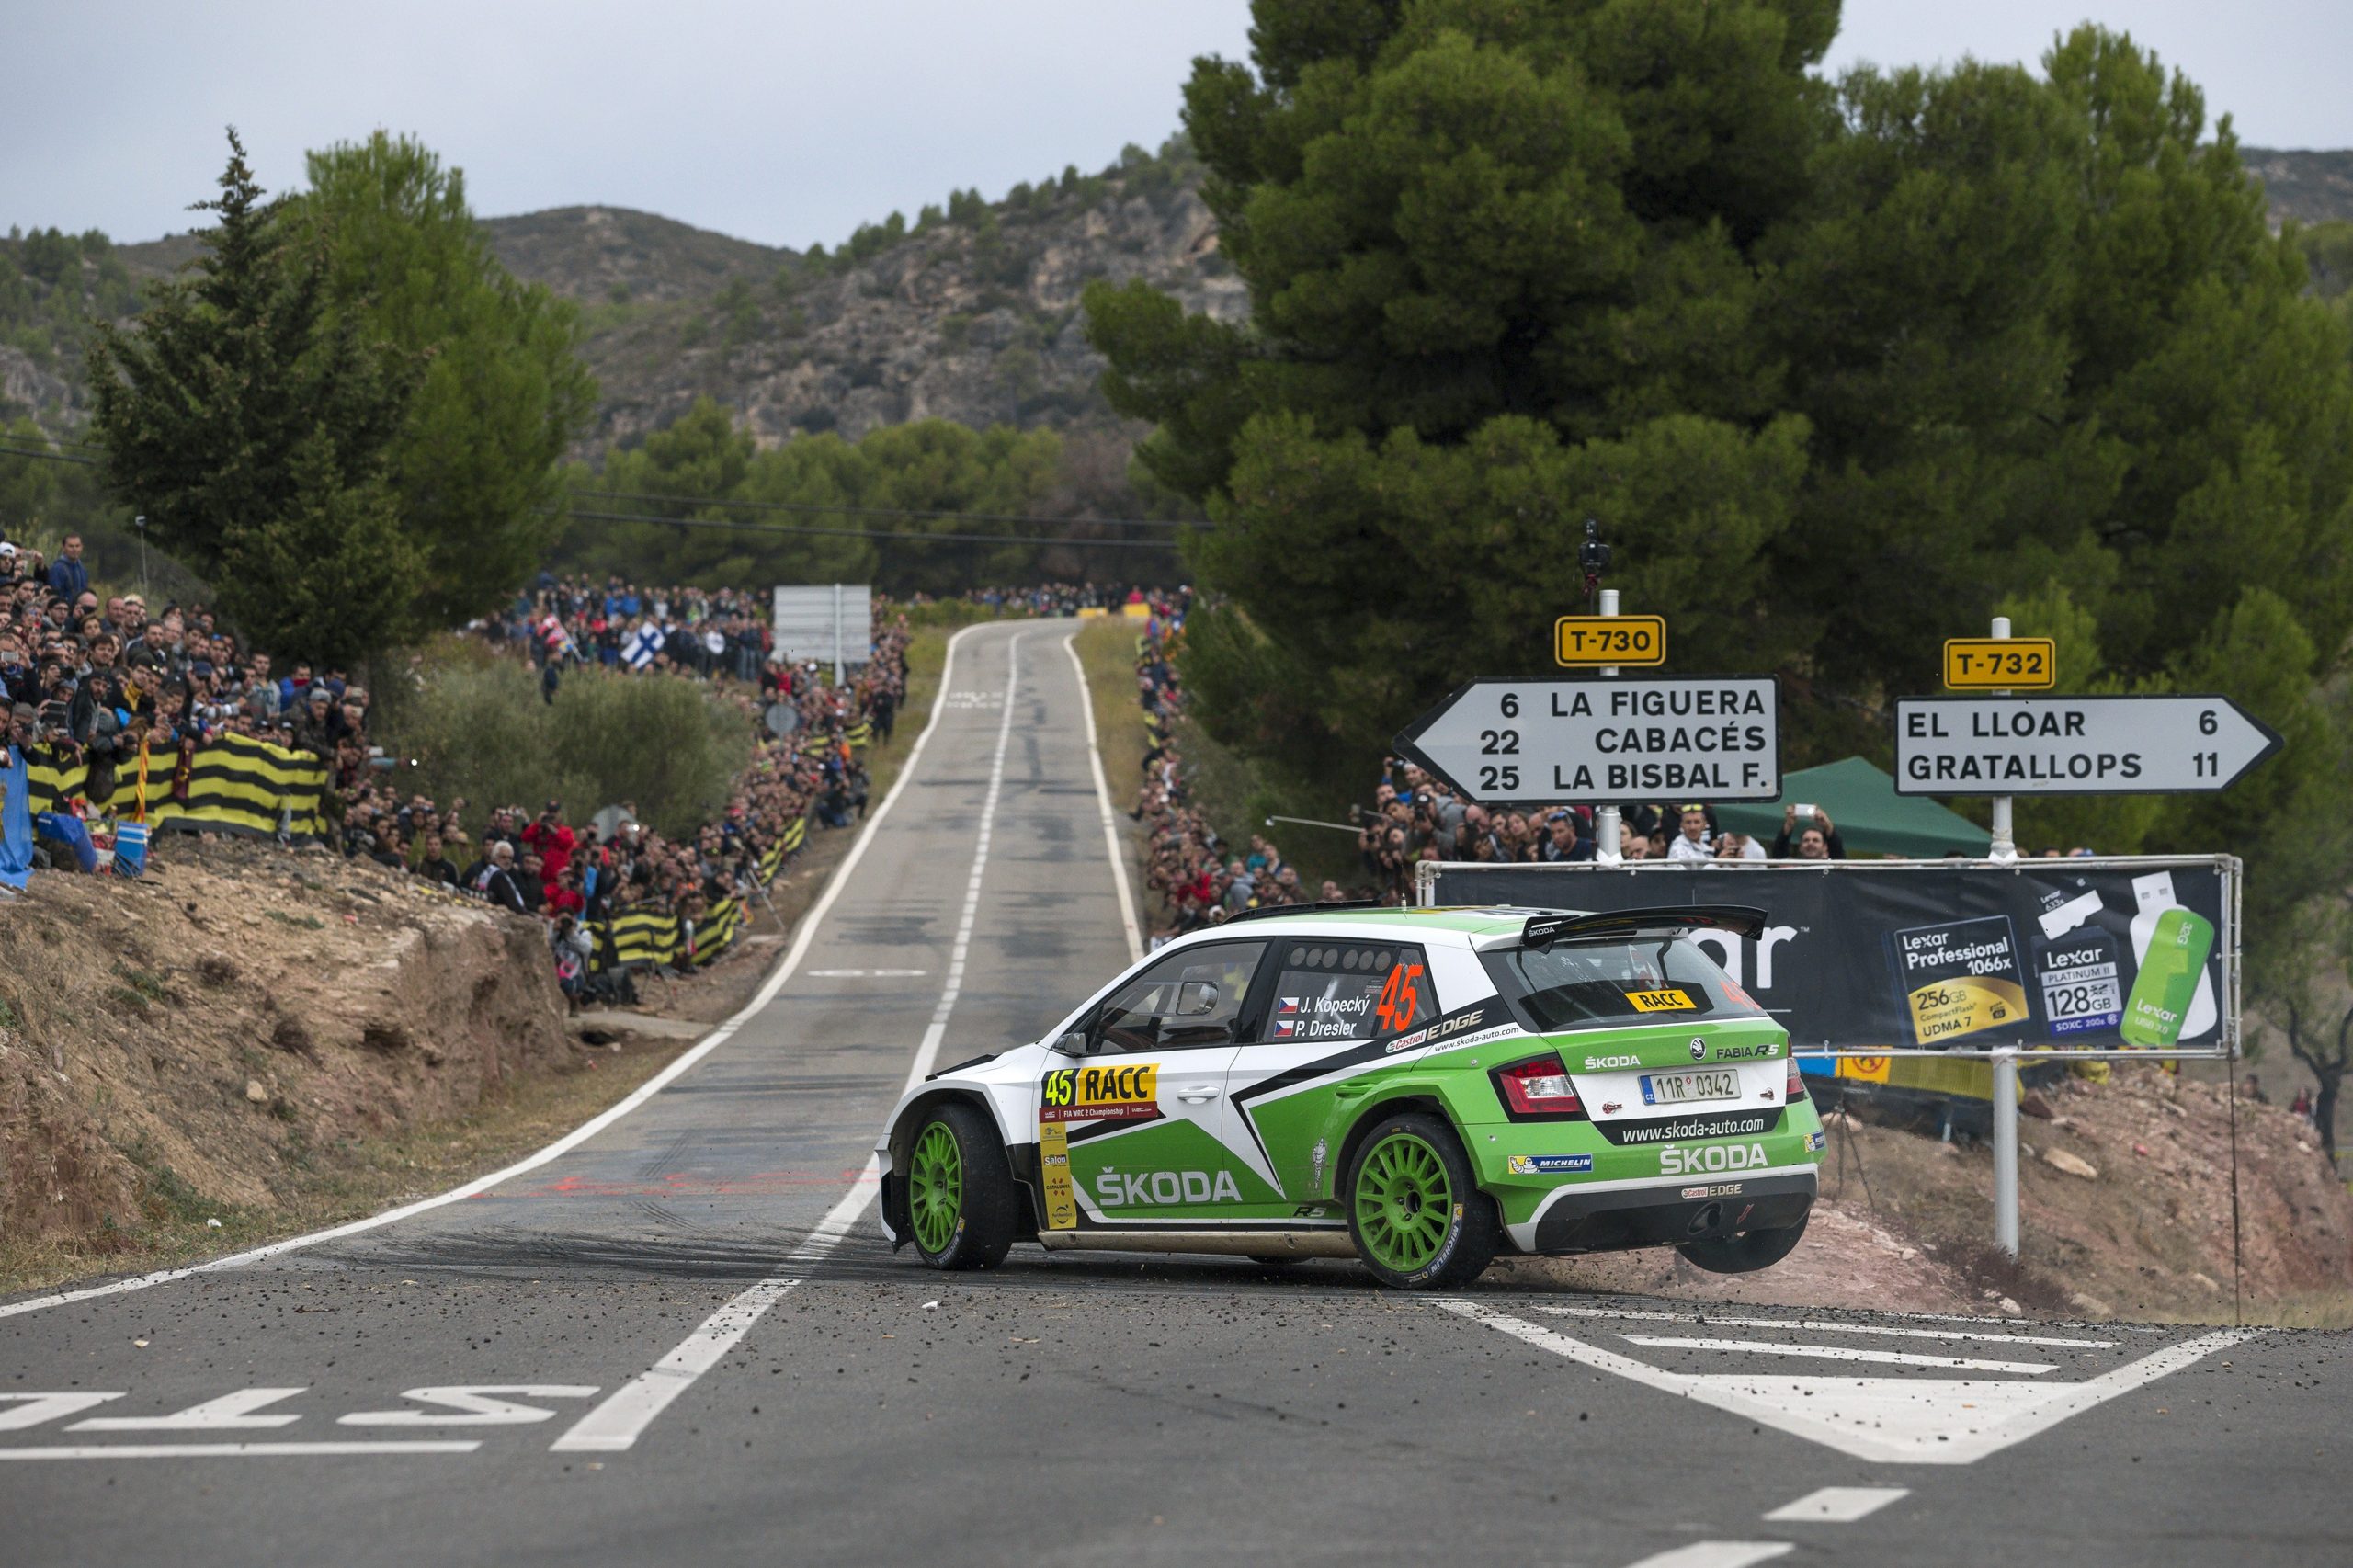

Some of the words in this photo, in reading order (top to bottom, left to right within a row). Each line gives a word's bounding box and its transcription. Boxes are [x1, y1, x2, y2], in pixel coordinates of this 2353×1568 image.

[1570, 630, 1651, 653] T-730
[1957, 653, 2043, 676] T-732
[1500, 693, 1519, 719] 6
[1552, 692, 1593, 718] LA
[1611, 690, 1766, 717] FIGUERA
[1908, 712, 1949, 737] EL
[1973, 711, 2086, 737] LLOAR
[2199, 710, 2218, 735] 6
[1481, 730, 1519, 756] 22
[1596, 721, 1767, 754] CABACÉS
[1480, 766, 1519, 791] 25
[1554, 764, 1595, 790] LA
[1608, 763, 1730, 790] BISBAL
[1743, 762, 1767, 788] F.
[1908, 753, 2143, 780] GRATALLOPS
[2192, 752, 2218, 778] 11
[1903, 933, 1949, 950] Lexar
[1906, 937, 2009, 970] Professional
[2047, 949, 2103, 969] Lexar
[1967, 956, 2012, 975] 1066x
[2048, 968, 2101, 983] PLATINUM
[1300, 997, 1311, 1014] J.
[1314, 994, 1370, 1017] Kopecký
[1376, 964, 1424, 1031] 45
[1638, 992, 1683, 1008] RACC
[2136, 998, 2178, 1022] Lexar
[1295, 1020, 1305, 1036] P.
[1309, 1019, 1357, 1037] Dresler
[1395, 1032, 1424, 1049] Castrol
[1427, 1009, 1484, 1041] EDGE
[1923, 1019, 1962, 1037] UDMA
[1964, 1017, 1972, 1027] 7
[2056, 1020, 2083, 1032] SDXC
[1435, 1028, 1519, 1051] www.skoda-auto.com
[1585, 1054, 1641, 1071] ŠKODA
[1716, 1047, 1752, 1059] FABIA
[1754, 1044, 1779, 1056] R5
[1046, 1070, 1074, 1106] 45
[1086, 1066, 1150, 1101] RACC
[1656, 1076, 1686, 1100] 11R
[1696, 1074, 1733, 1096] 0342
[1089, 1108, 1124, 1117] Championship
[1622, 1117, 1764, 1142] www.skoda-auto.com
[1044, 1156, 1066, 1165] Salou
[1540, 1158, 1591, 1168] MICHELIN
[1660, 1142, 1768, 1176] ŠKODA
[1096, 1166, 1244, 1207] ŠKODA
[1688, 1187, 1707, 1198] Castrol
[1709, 1184, 1743, 1197] EDGE
[1293, 1206, 1327, 1218] R5
[1431, 1224, 1460, 1274] MICHELIN
